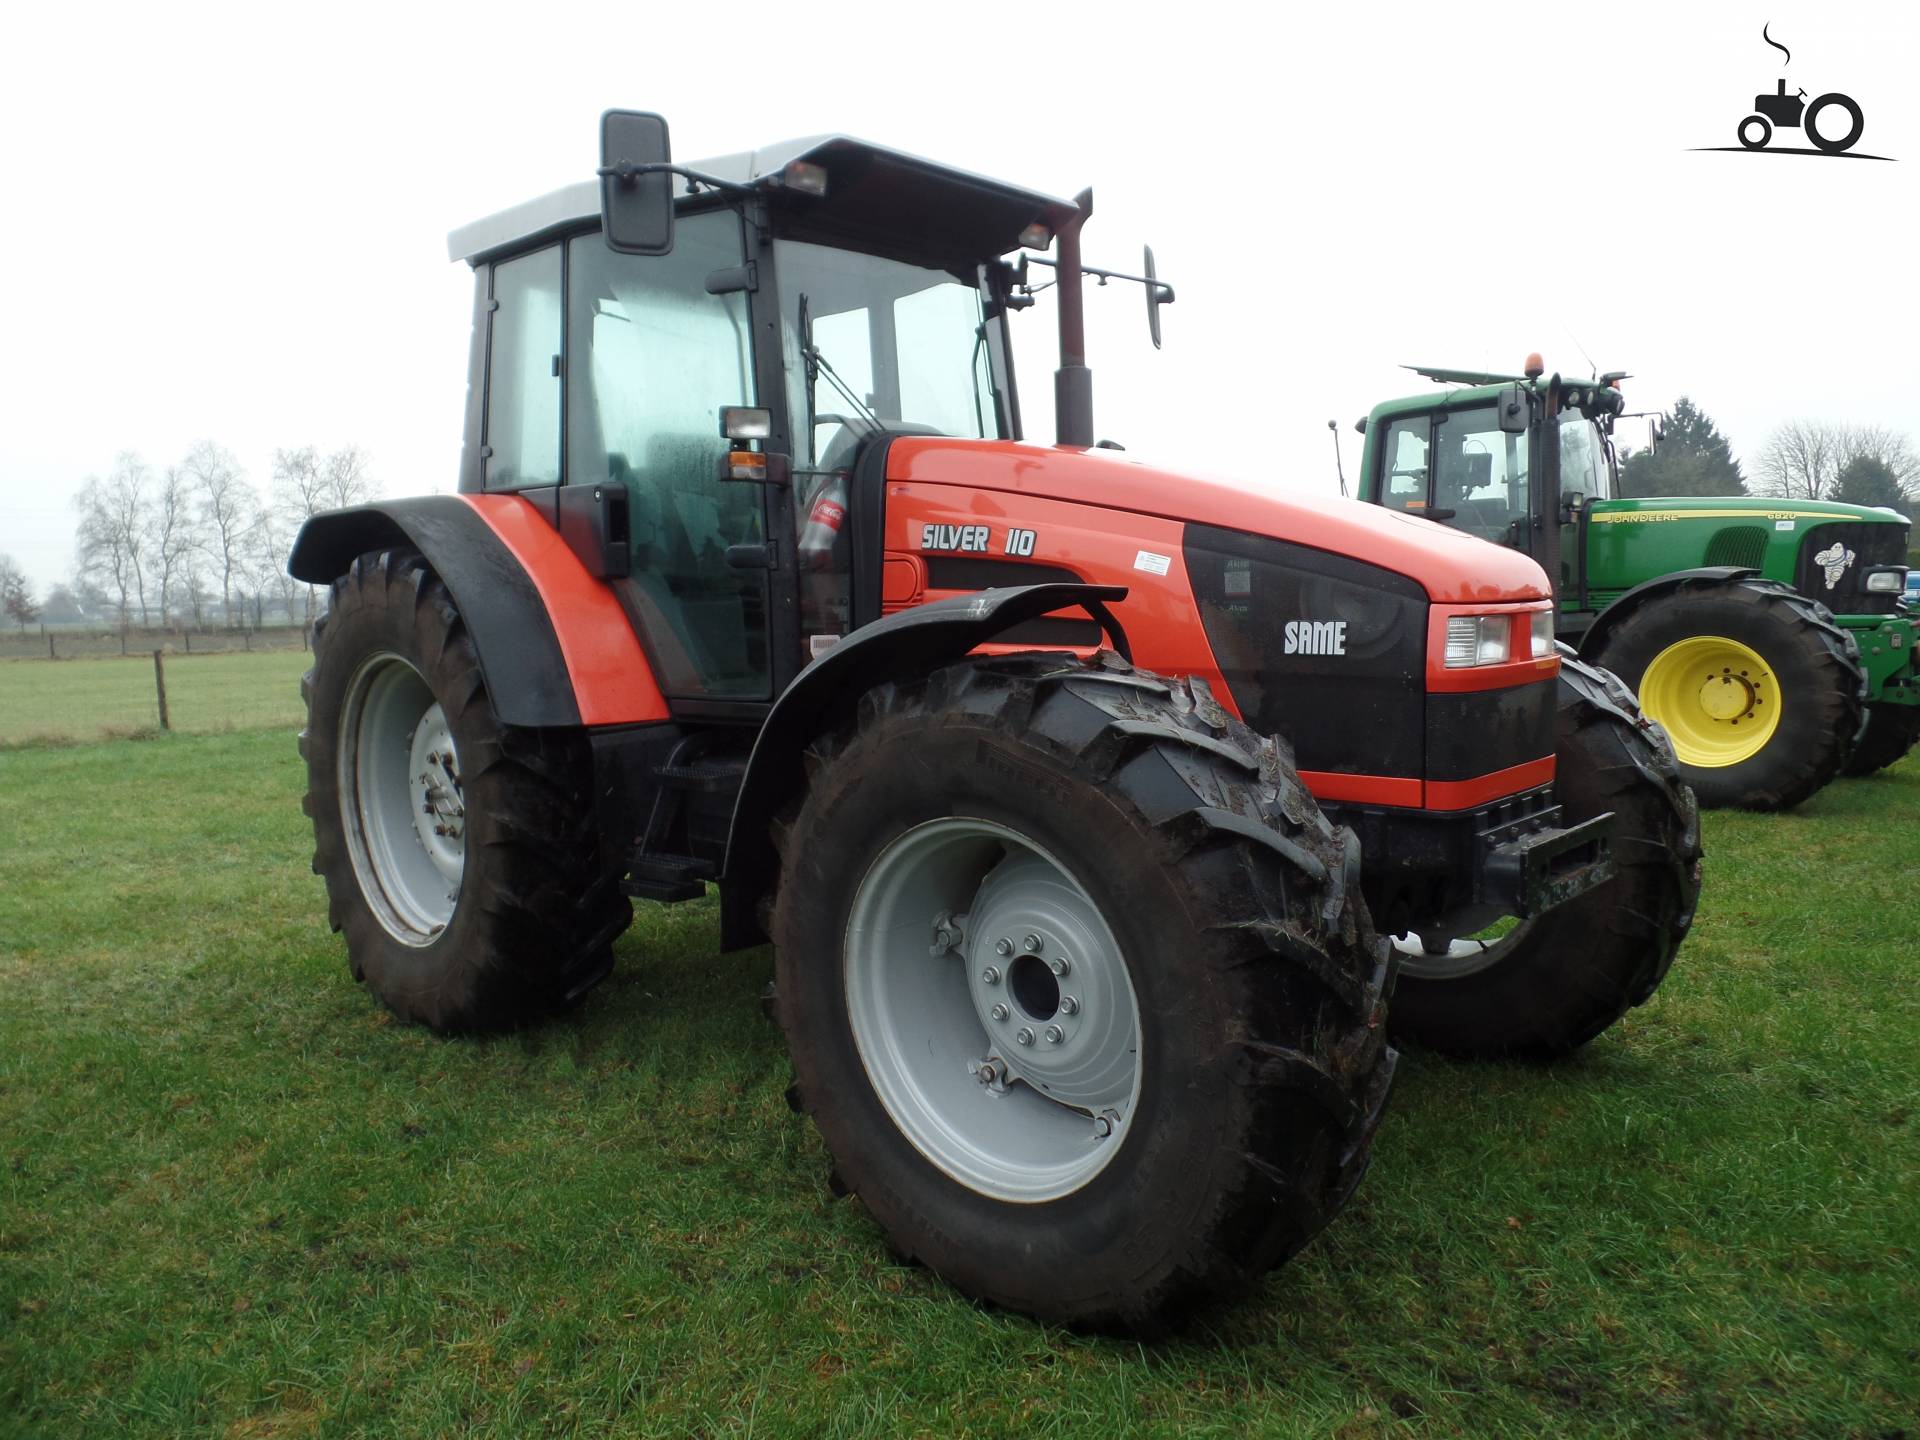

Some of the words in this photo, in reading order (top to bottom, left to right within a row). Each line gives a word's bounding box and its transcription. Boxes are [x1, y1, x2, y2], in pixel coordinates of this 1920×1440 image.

[1608, 513, 1638, 524] JOHN
[1639, 512, 1679, 522] DEERE
[921, 523, 990, 552] SILVER
[1004, 527, 1037, 557] 110
[1284, 621, 1347, 655] SAME
